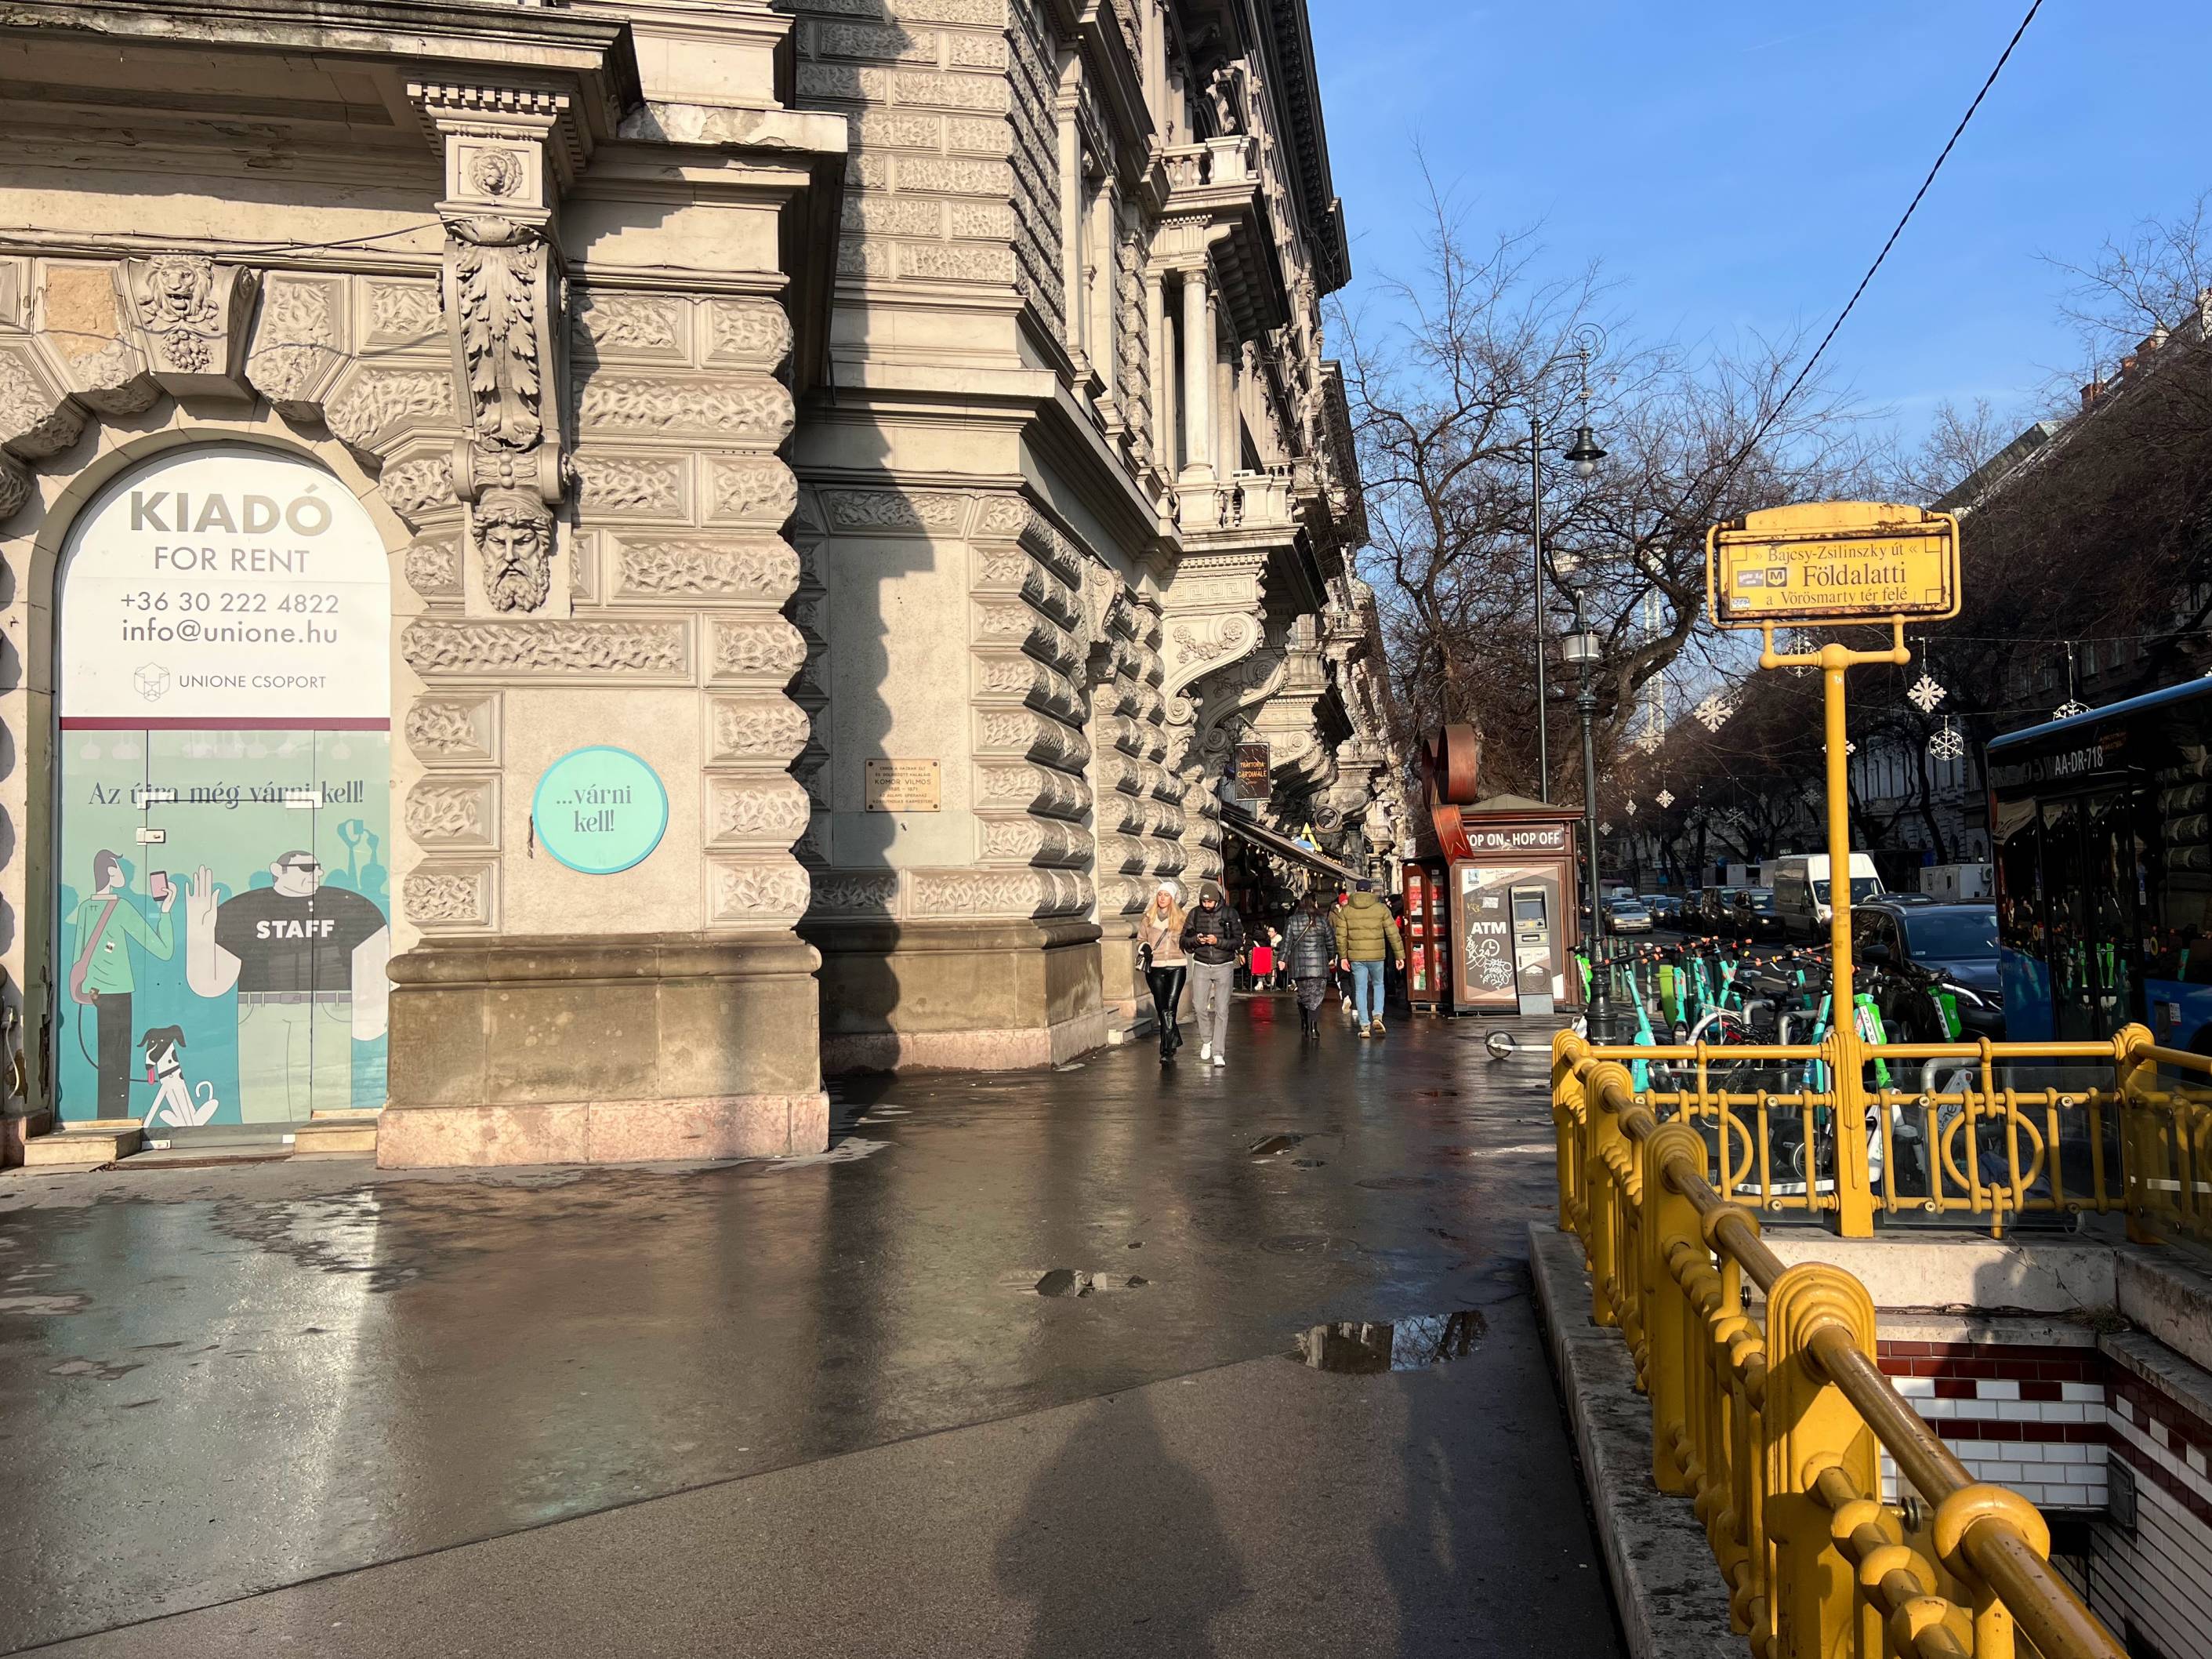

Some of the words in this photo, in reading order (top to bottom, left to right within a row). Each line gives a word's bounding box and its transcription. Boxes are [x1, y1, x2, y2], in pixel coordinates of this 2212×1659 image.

[130, 483, 333, 537] KIADÓ
[154, 546, 218, 571] FOR
[231, 549, 310, 573] RENT
[1768, 544, 1887, 564] Bajcsy-Zsilinszky
[1891, 542, 1904, 556] út
[1802, 561, 1907, 587] Földalatti
[121, 591, 169, 612] +36
[179, 592, 211, 612] 30
[219, 593, 267, 613] 222
[276, 594, 339, 614] 4822
[1766, 595, 1773, 605] a
[1780, 590, 1856, 605] Vörösmarty
[1861, 588, 1880, 602] tér
[1882, 586, 1908, 602] felé
[122, 617, 339, 644] info@unione.hu
[179, 674, 246, 688] UNIONE
[252, 675, 327, 689] CSOPORT
[2054, 745, 2104, 775] AA-DR-718
[88, 782, 121, 804] Az
[189, 781, 241, 811] még
[249, 781, 311, 804] várni
[321, 780, 364, 804] kell!
[556, 783, 633, 804] ...várni
[573, 809, 615, 833] kell!
[1487, 833, 1504, 846] ON
[1512, 832, 1536, 846] HOP
[1539, 831, 1560, 845] OFF
[256, 919, 335, 940] STAFF
[1470, 921, 1507, 934] ATM
[1478, 948, 1491, 957] 24
